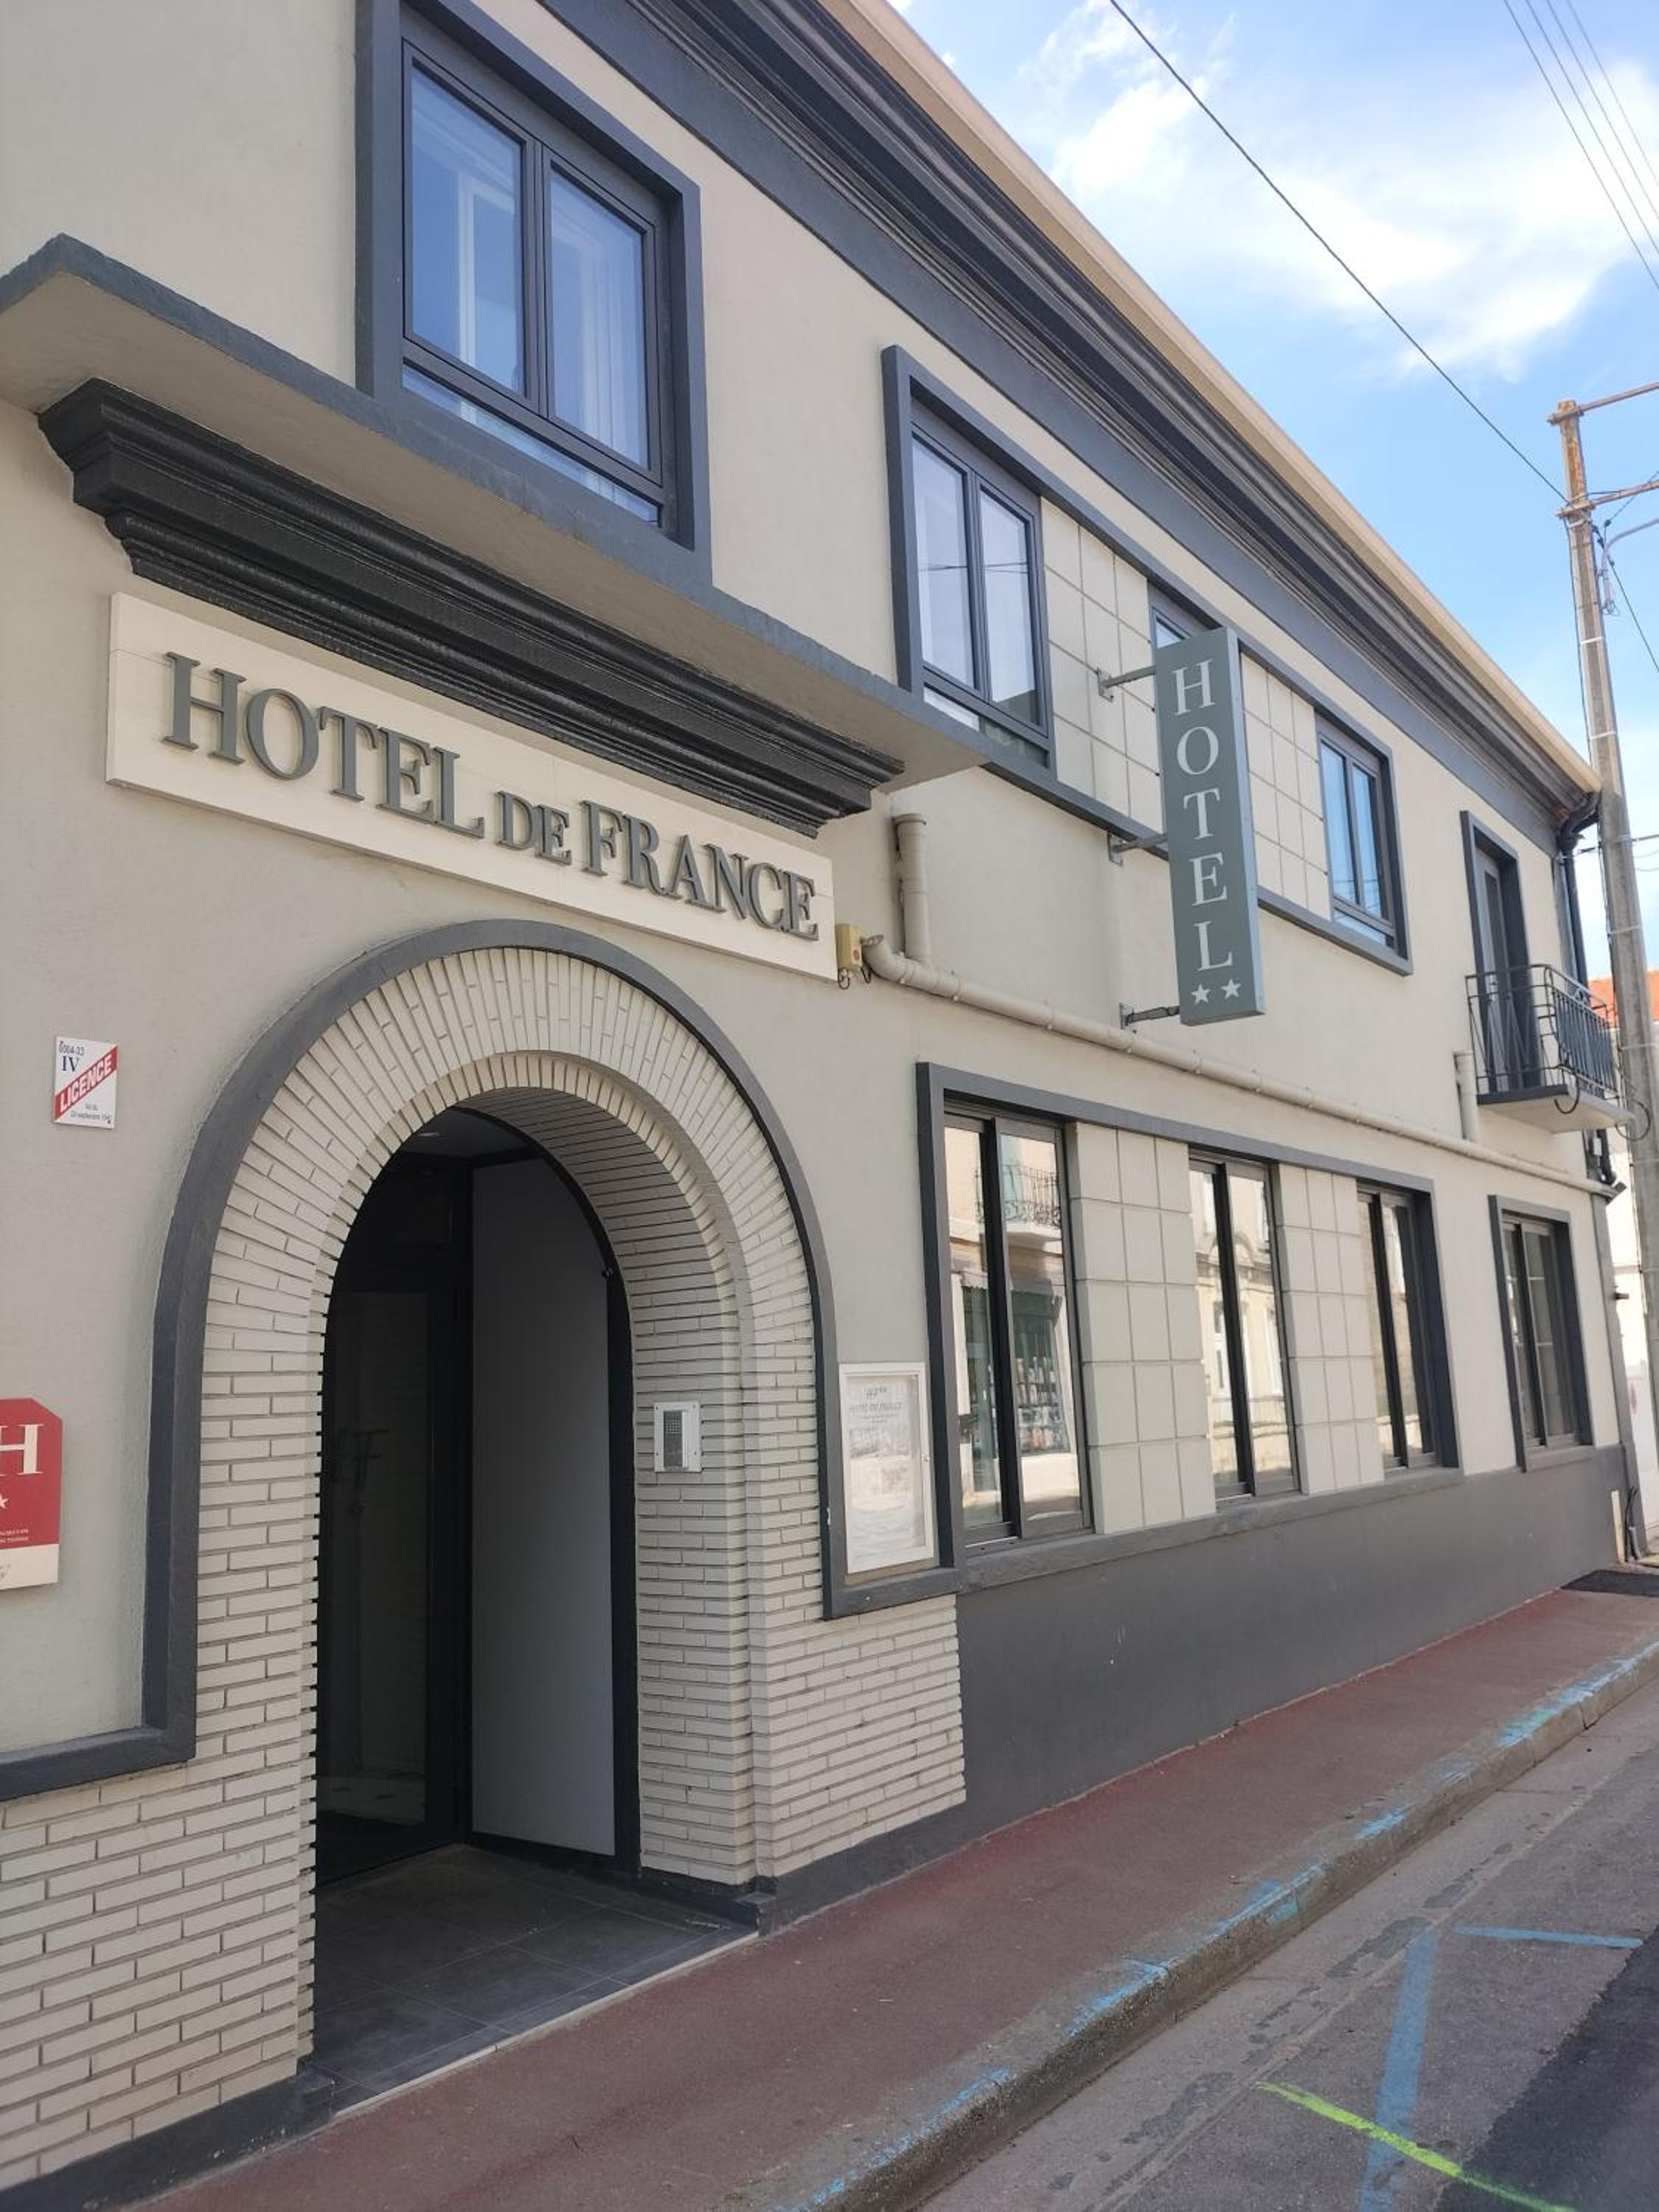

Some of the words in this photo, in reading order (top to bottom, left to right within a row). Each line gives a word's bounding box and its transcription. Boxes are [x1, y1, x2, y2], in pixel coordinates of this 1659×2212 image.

[163, 650, 485, 840] HOTEL
[495, 789, 572, 866] DE
[580, 799, 820, 942] FRANCE
[1172, 658, 1233, 972] HOTEL
[60, 1053, 112, 1114] LICENCE
[62, 1055, 79, 1072] IV
